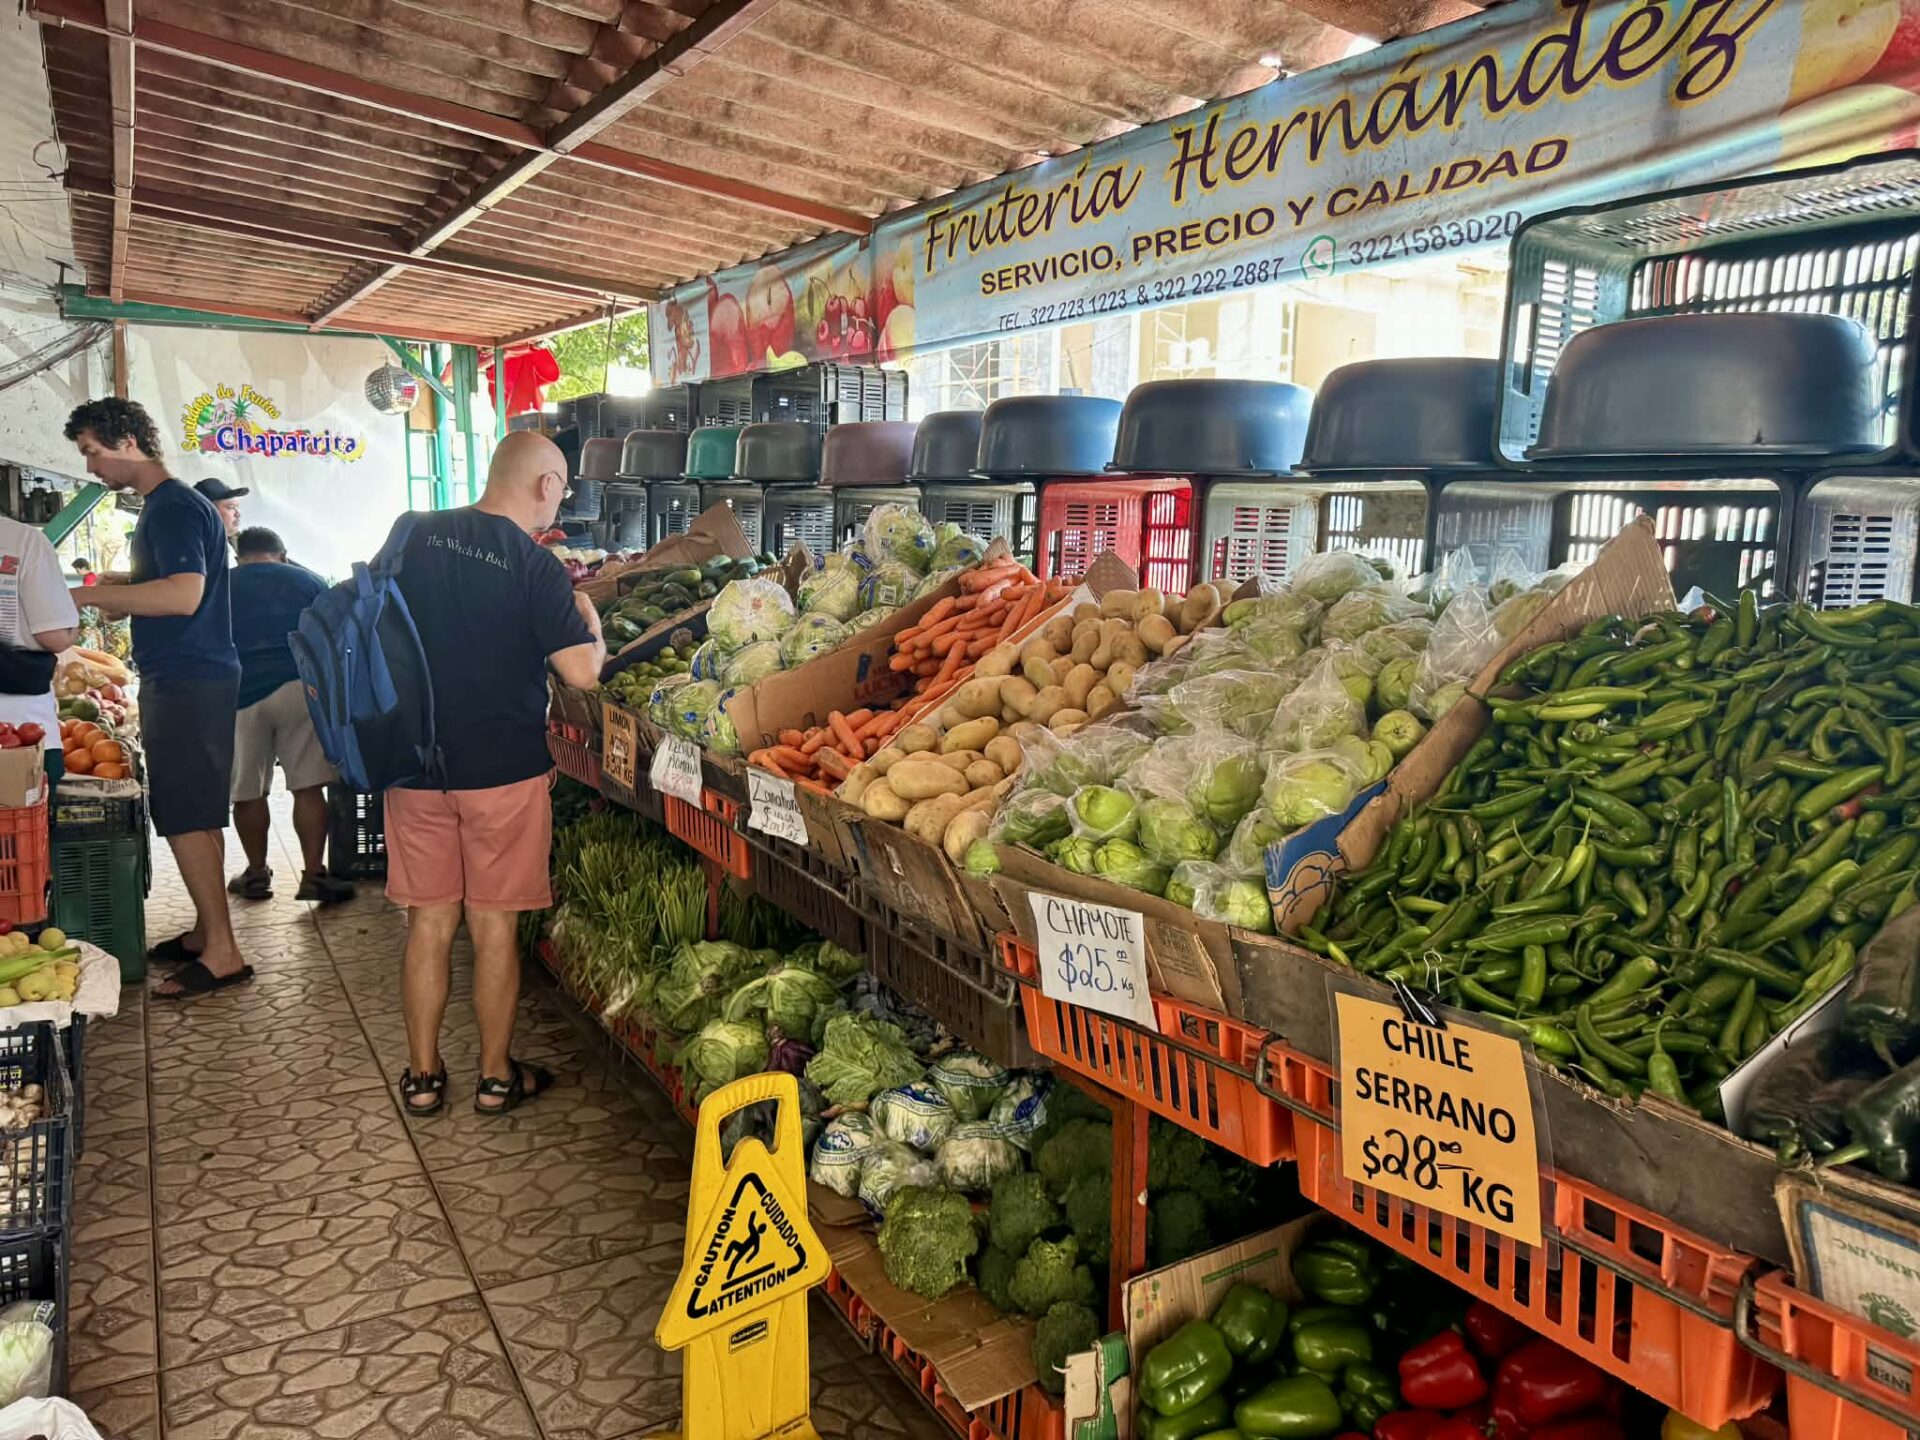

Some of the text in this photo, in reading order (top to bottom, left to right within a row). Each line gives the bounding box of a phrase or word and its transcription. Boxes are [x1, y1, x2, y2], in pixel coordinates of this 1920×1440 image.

[926, 0, 1775, 272] Frutería Hernández
[981, 139, 1569, 295] SERVICIO, PRECIO Y CALIDAD
[999, 210, 1523, 332] TEL. 322 223 1223 & 322 222 2887 3221583020
[217, 383, 235, 400] de
[241, 384, 282, 420] Frutas
[216, 426, 357, 457] Chaparrita
[427, 534, 444, 547] The
[485, 551, 509, 571] Back
[1382, 1018, 1474, 1073] CHILE
[1355, 1066, 1517, 1145] SERRANO
[760, 1191, 798, 1248] CUIDADO
[1462, 1171, 1515, 1224] KG
[694, 1206, 737, 1288] CAUTION
[708, 1267, 788, 1317] ATTENTION
